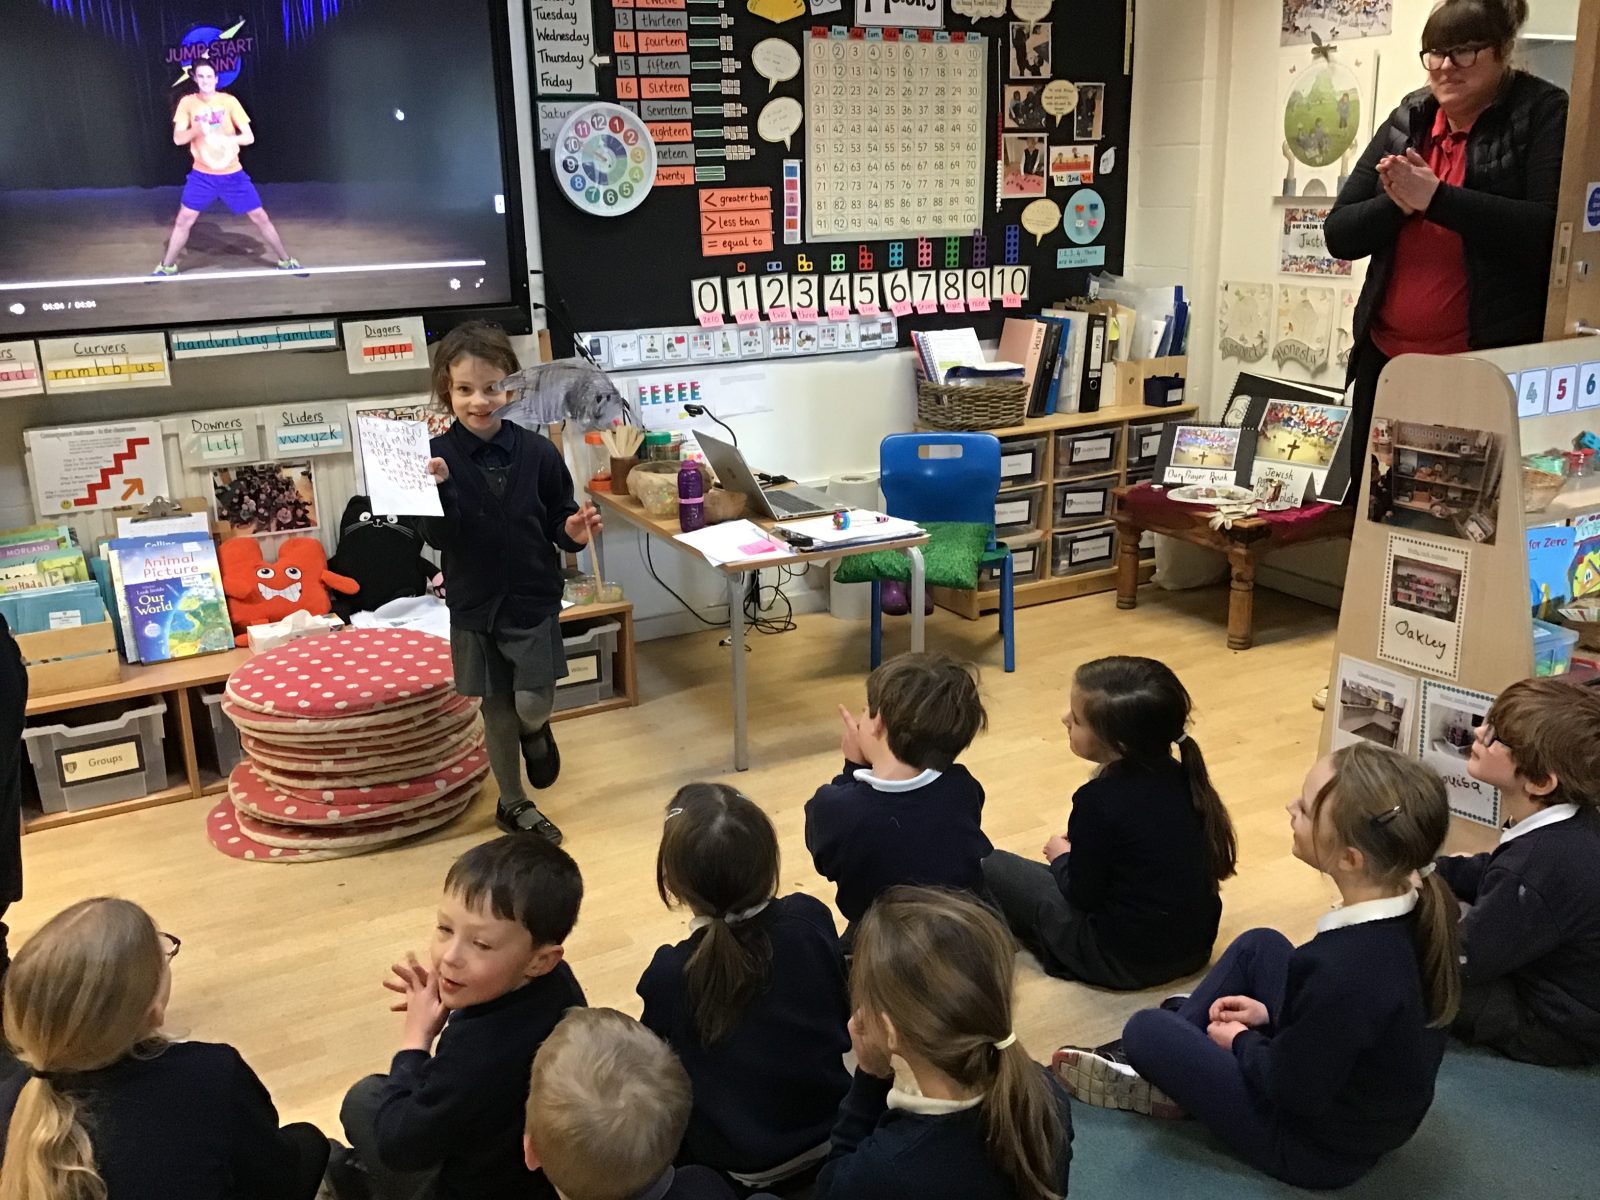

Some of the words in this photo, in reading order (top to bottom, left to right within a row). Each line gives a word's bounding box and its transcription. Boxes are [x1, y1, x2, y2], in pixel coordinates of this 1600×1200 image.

[533, 6, 577, 25] Tuesday
[617, 12, 629, 25] 13
[642, 13, 682, 27] thirteen
[536, 27, 589, 46] Wednesday
[619, 34, 629, 49] 14
[645, 34, 684, 51] fourteen
[165, 44, 207, 63] JUMP
[210, 38, 253, 57] START
[537, 49, 584, 69] Thursday
[620, 61, 630, 71] 15
[647, 60, 680, 73] fifteen
[816, 66, 824, 74] 11
[834, 66, 843, 75] 12
[852, 67, 860, 76] 13
[870, 67, 878, 75] 14
[887, 67, 895, 76] 15
[904, 67, 912, 76] 16
[921, 68, 928, 77] 17
[936, 68, 945, 77] 18
[953, 68, 961, 76] 19
[969, 68, 977, 77] 20
[541, 72, 572, 92] Friday
[621, 82, 632, 93] 16
[648, 82, 685, 94] sixteen
[815, 86, 824, 94] 21
[833, 86, 843, 95] 22
[851, 86, 860, 95] 23
[868, 87, 878, 95] 24
[885, 87, 895, 95] 25
[902, 87, 912, 96] 26
[919, 87, 928, 95] 27
[936, 87, 945, 95] 28
[952, 87, 961, 95] 29
[968, 87, 977, 95] 30
[540, 105, 573, 119] Satur
[647, 105, 688, 116] seventeen
[591, 115, 607, 129] 12
[613, 119, 620, 131] 1
[577, 124, 588, 136] 11
[650, 125, 689, 140] eighteen
[627, 131, 636, 144] 2
[566, 139, 579, 151] 10
[634, 150, 642, 161] 3
[657, 147, 688, 160] neteen
[567, 158, 575, 170] 9
[817, 163, 825, 172] 61
[834, 163, 844, 171] 62
[851, 163, 860, 171] 63
[868, 163, 878, 171] 64
[885, 162, 894, 171] 65
[901, 162, 911, 170] 66
[918, 161, 927, 170] 67
[935, 161, 944, 169] 68
[951, 161, 959, 169] 69
[967, 161, 976, 169] 70
[632, 169, 640, 180] 4
[656, 169, 685, 184] twenty
[574, 177, 582, 189] 8
[623, 184, 630, 195] 5
[588, 189, 596, 201] 7
[607, 191, 615, 203] 6
[720, 194, 748, 206] greater
[750, 192, 768, 202] than
[719, 216, 736, 228] less
[740, 217, 760, 226] than
[723, 238, 748, 251] equal
[753, 237, 762, 246] to
[1299, 233, 1324, 248] Justi
[698, 282, 717, 313] 0
[737, 280, 749, 310] 1
[766, 278, 786, 309] 2
[797, 278, 813, 308] 3
[829, 278, 846, 306] 4
[858, 276, 874, 304] 5
[890, 274, 906, 303] 6
[917, 273, 932, 300] 7
[944, 272, 960, 300] 8
[972, 271, 986, 298] 9
[997, 268, 1027, 296] 10
[739, 313, 754, 321] one
[772, 311, 787, 319] two
[799, 311, 817, 319] three
[830, 310, 845, 319] four
[177, 330, 269, 350] handwriting
[275, 324, 332, 348] families
[364, 324, 401, 337] Diggers
[73, 342, 127, 355] Curvers
[1526, 382, 1537, 404] 4
[1556, 378, 1567, 400] 5
[1586, 373, 1596, 395] 6
[282, 411, 324, 425] Sliders
[192, 418, 242, 432] Downers
[1168, 469, 1181, 478] Our
[1185, 469, 1206, 481] Prayer
[1209, 471, 1228, 481] Book
[1265, 467, 1293, 480] Jewish
[1280, 492, 1299, 504] plate
[1544, 537, 1568, 548] Zero
[6, 544, 50, 556] MORLAND
[144, 552, 194, 567] Animal
[144, 565, 199, 578] Picture
[138, 593, 165, 605] Our
[134, 600, 173, 616] World
[1395, 619, 1447, 660] Oakley
[88, 753, 123, 768] Groups
[1442, 774, 1483, 795] ouisa
